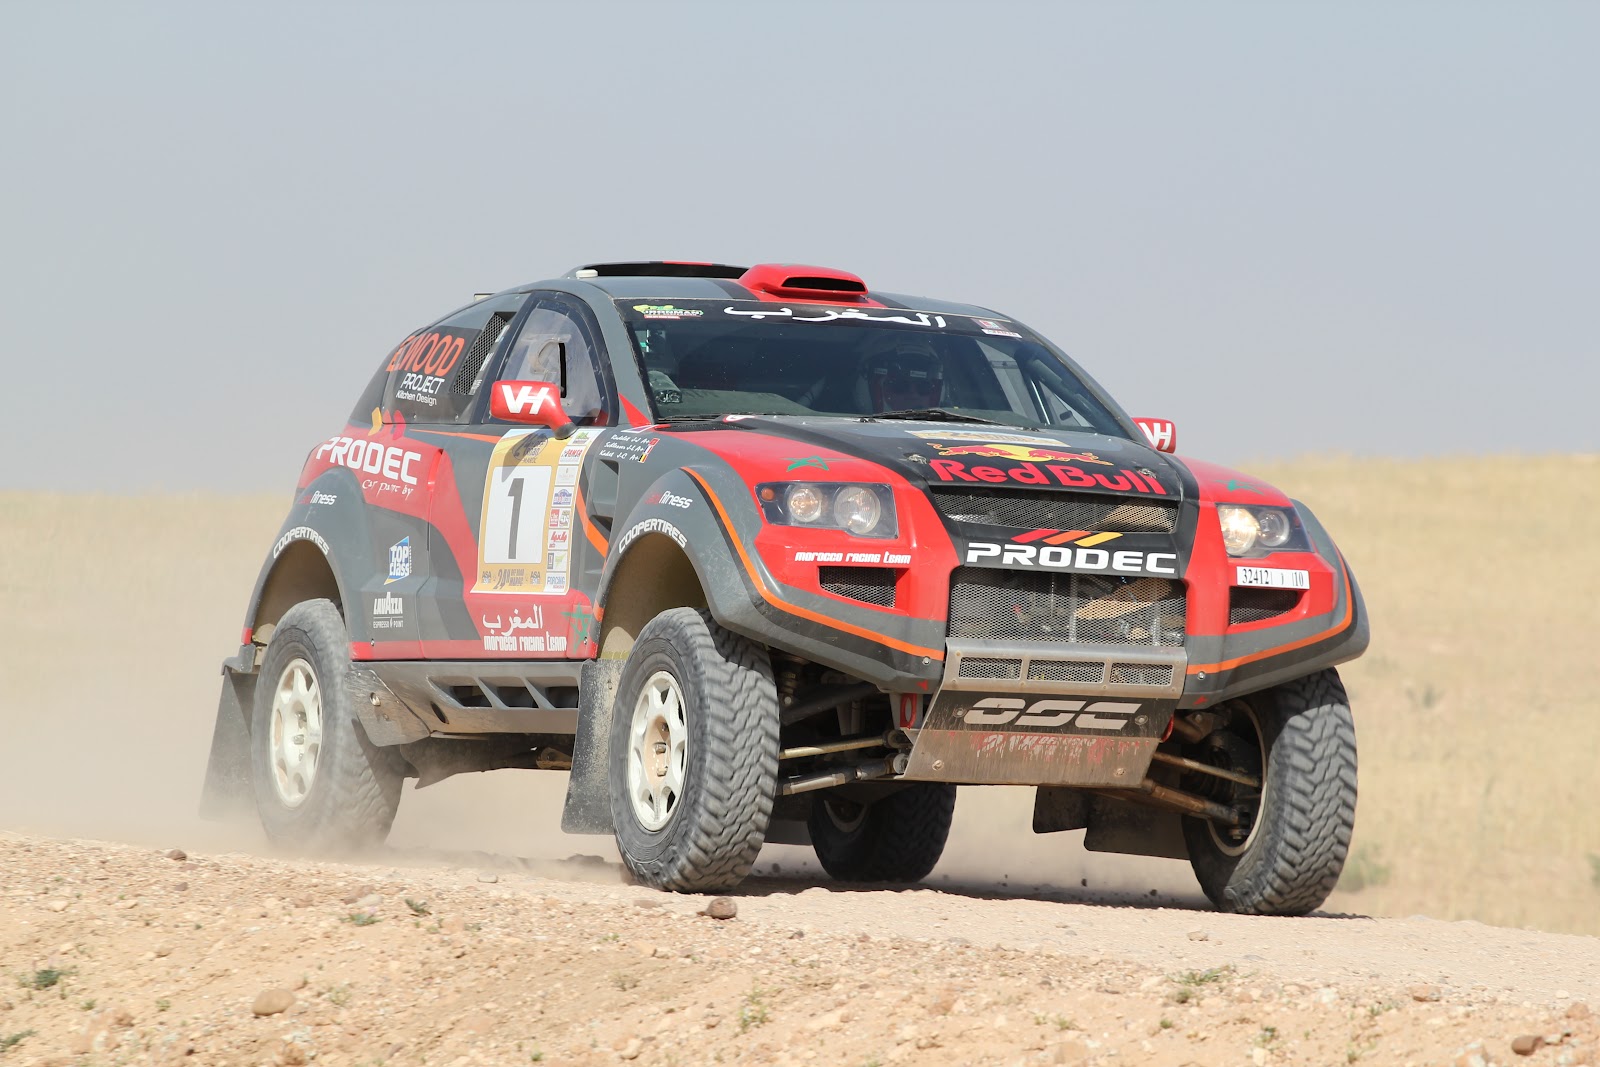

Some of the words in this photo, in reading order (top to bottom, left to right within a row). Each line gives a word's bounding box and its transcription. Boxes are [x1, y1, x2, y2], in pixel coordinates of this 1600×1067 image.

[396, 389, 416, 401] Kitchen
[416, 392, 437, 406] Design
[400, 372, 445, 395] PROJECT
[501, 384, 550, 415] VH
[1138, 422, 1172, 450] VH
[316, 436, 421, 485] PRODEC
[928, 458, 1049, 485] Red
[1049, 464, 1167, 495] Bull
[507, 478, 525, 560] 1
[389, 559, 410, 577] class
[390, 545, 409, 563] TOP
[966, 541, 1177, 574] PRODEC
[1242, 568, 1270, 585] 32412
[373, 591, 403, 615] LAVAZZA
[482, 603, 543, 637] المغرب
